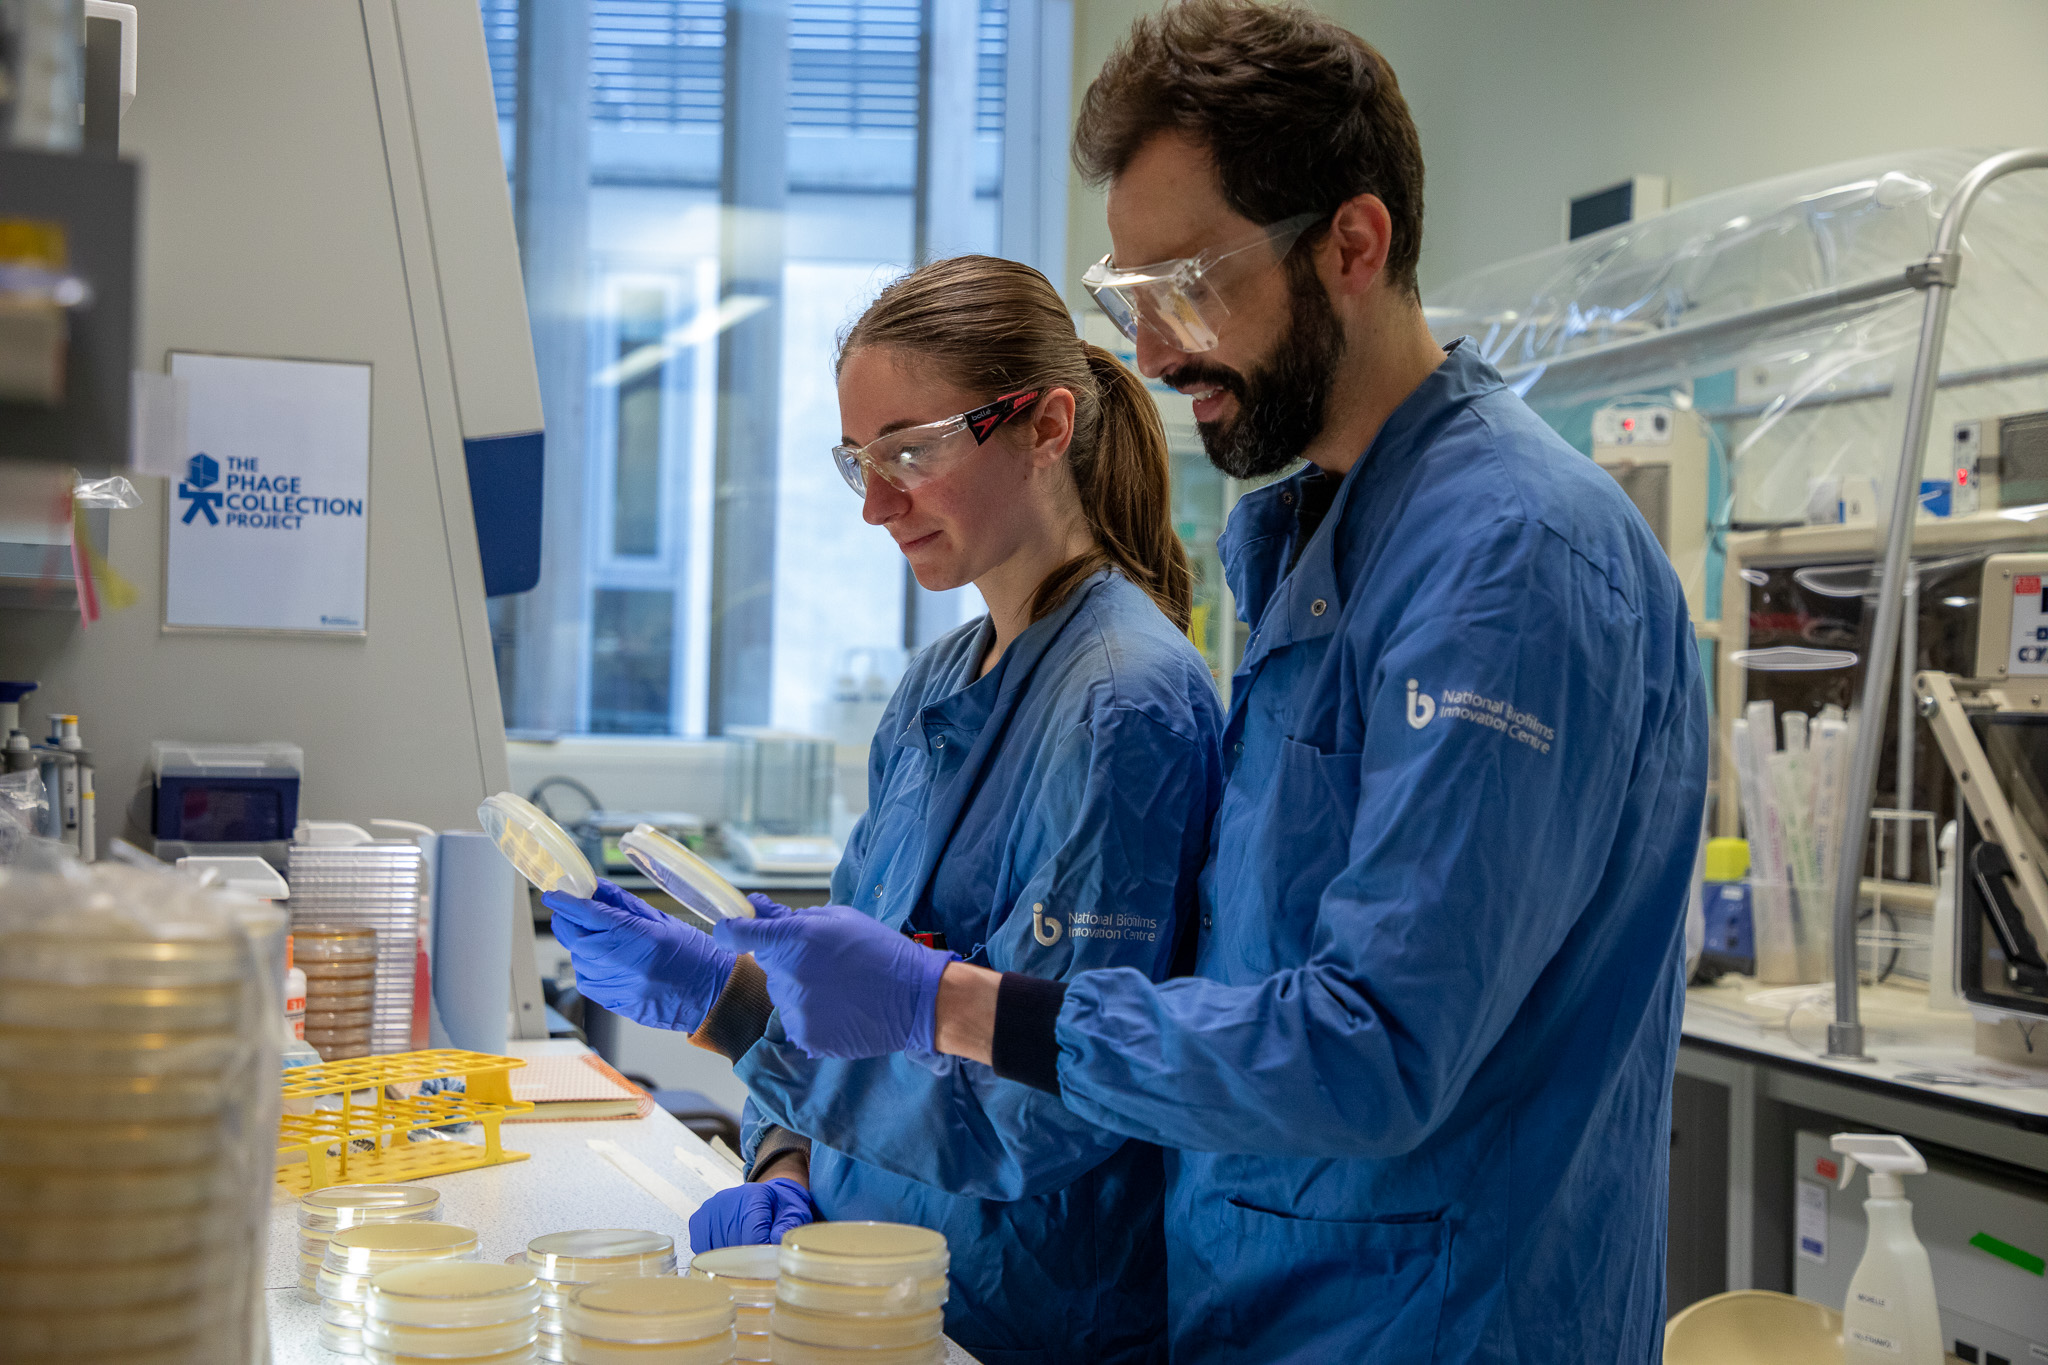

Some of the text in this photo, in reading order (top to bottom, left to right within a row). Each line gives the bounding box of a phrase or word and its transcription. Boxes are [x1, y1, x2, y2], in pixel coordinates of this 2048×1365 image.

[226, 456, 259, 473] THE
[226, 474, 302, 494] PHAGE
[226, 494, 363, 517] COLLECTION
[226, 513, 303, 530] PROJECT
[1442, 689, 1555, 741] National Biofilms
[1439, 706, 1551, 755] Innovation Centre
[1068, 911, 1157, 929] National Biofilms
[1068, 926, 1156, 942] Innovation Centre
